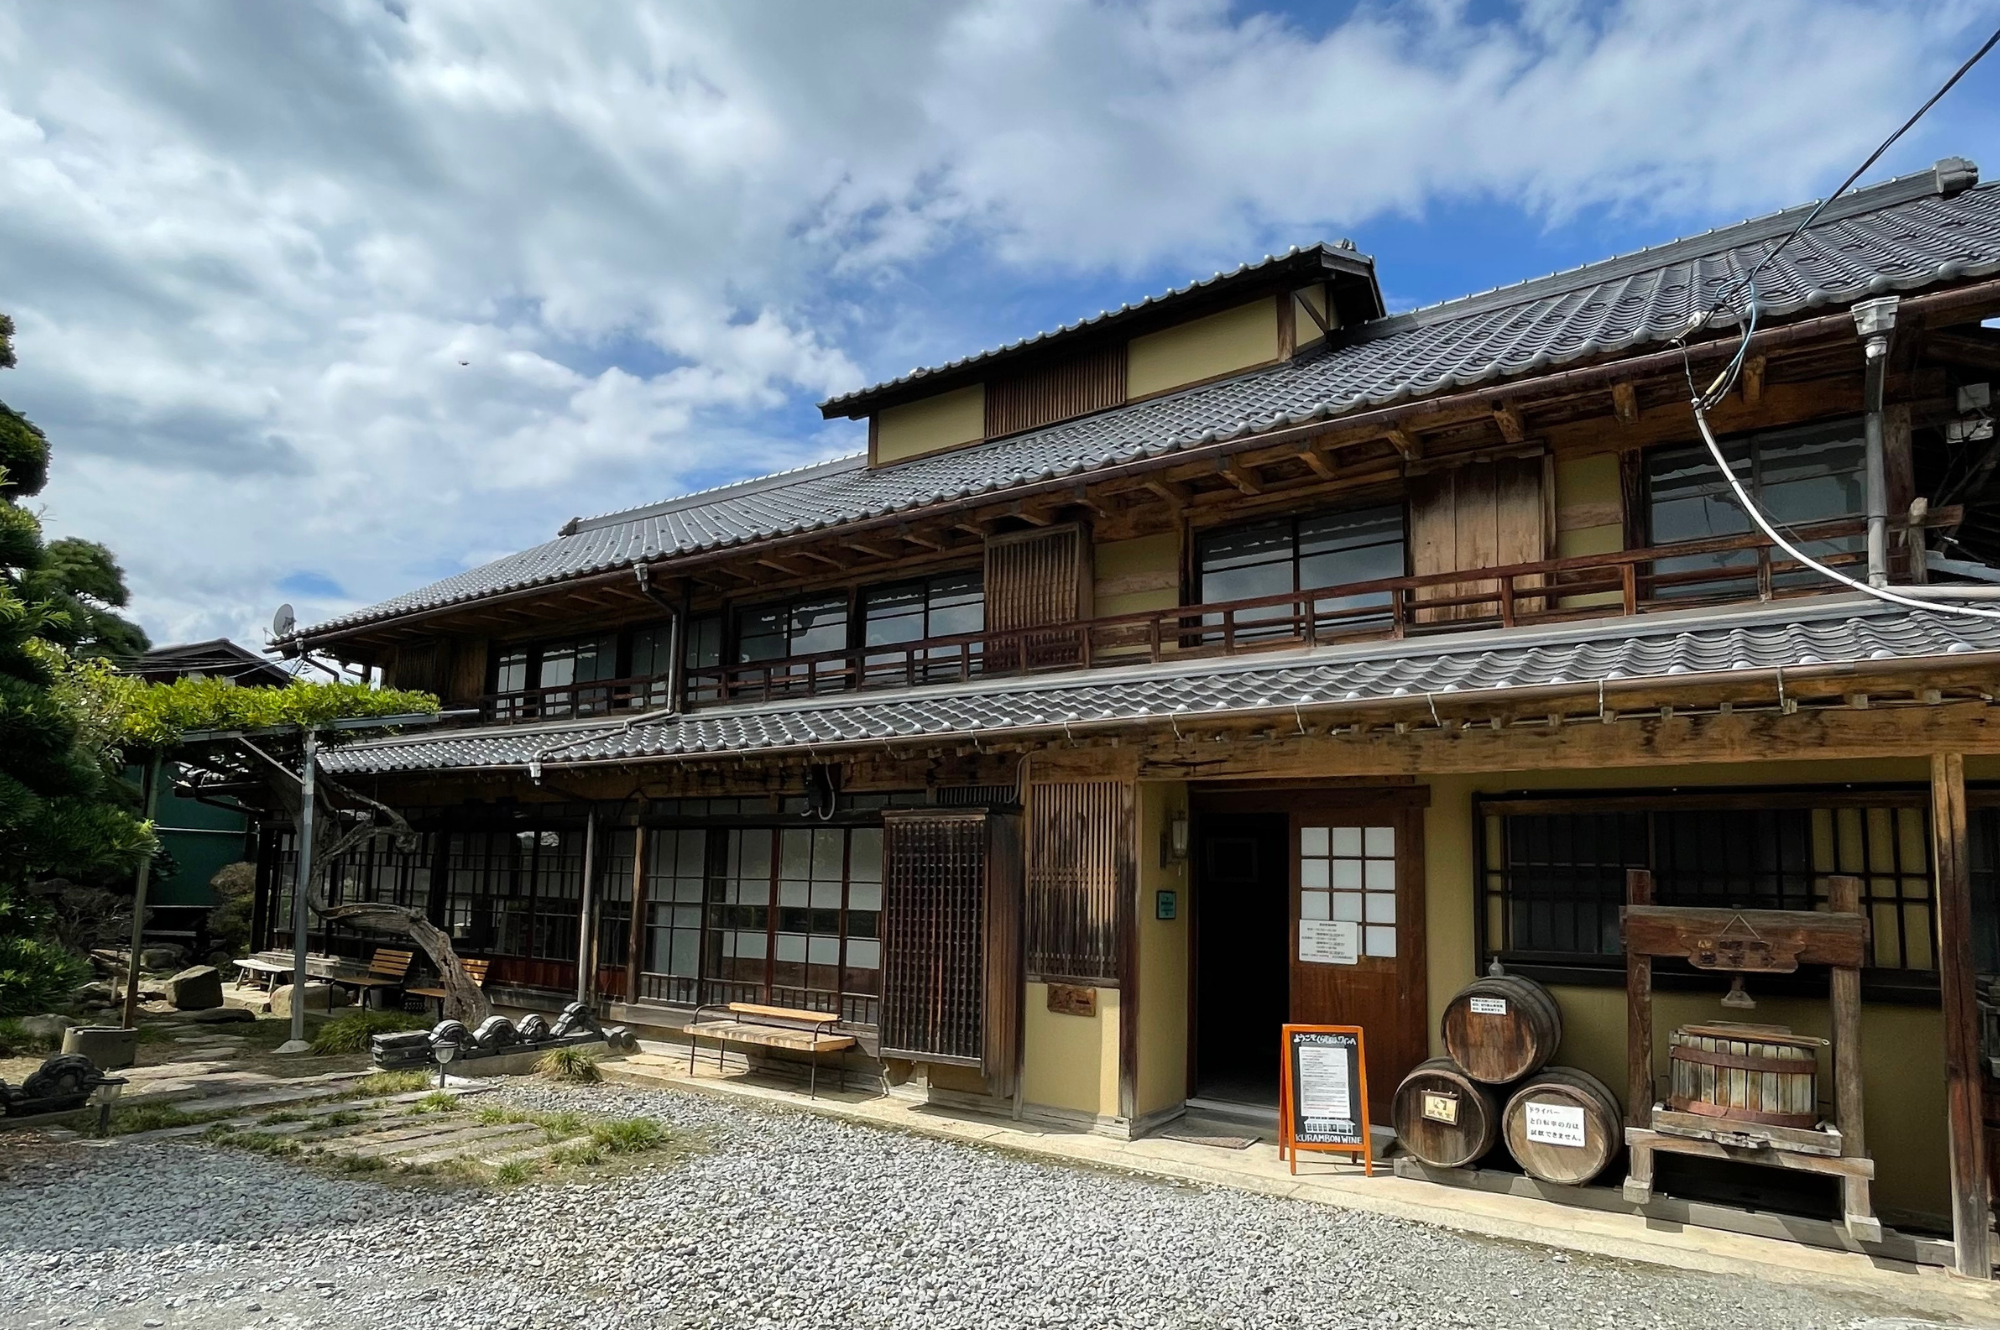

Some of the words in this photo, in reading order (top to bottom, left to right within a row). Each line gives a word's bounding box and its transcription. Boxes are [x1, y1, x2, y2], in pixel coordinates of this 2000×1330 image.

[1529, 1106, 1560, 1115] ドライバー
[1530, 1118, 1580, 1130] と自転車の方は
[1295, 1134, 1340, 1143] KURAMBON
[1341, 1136, 1362, 1144] WINE
